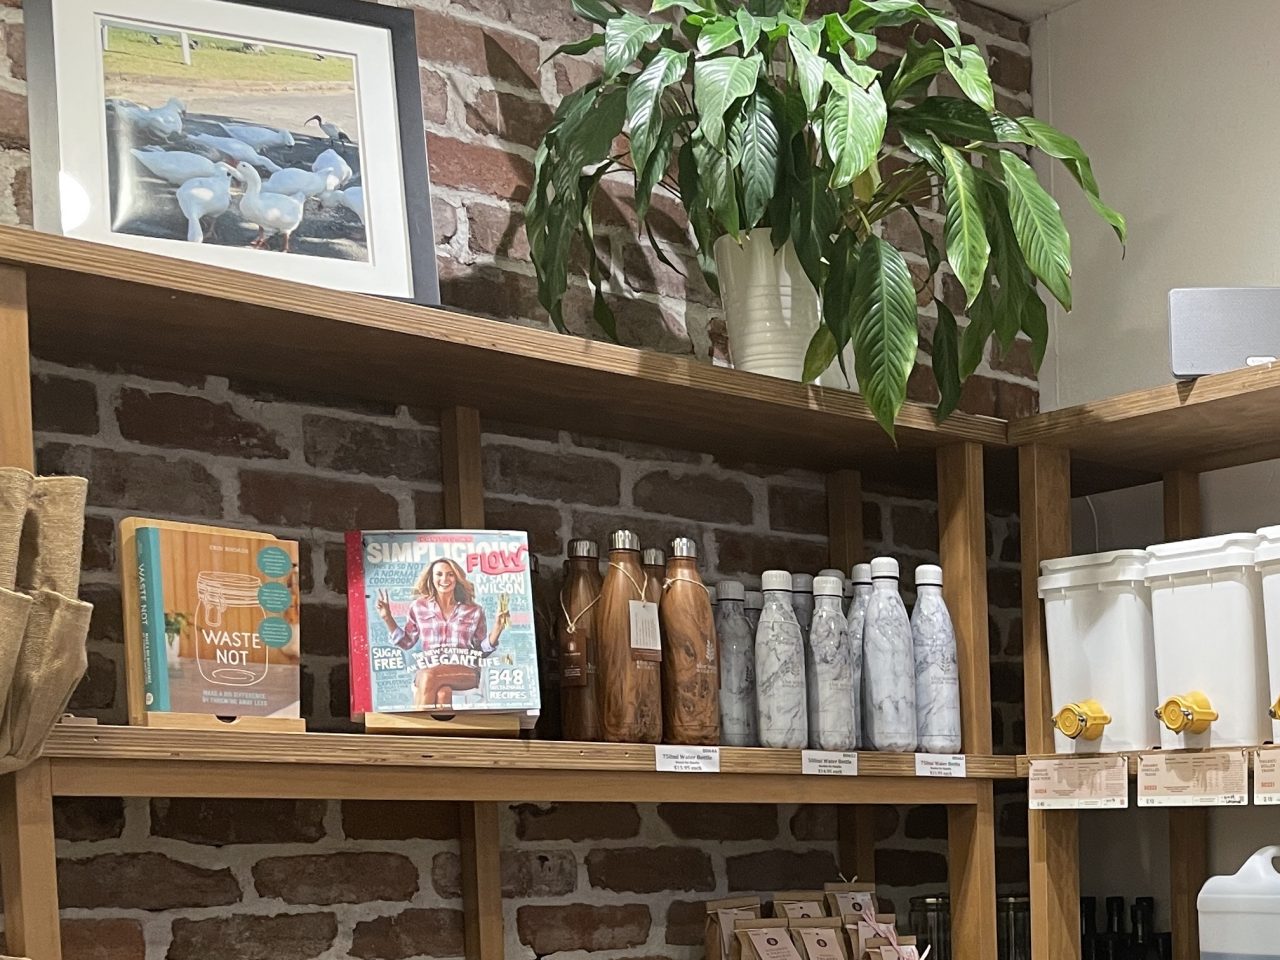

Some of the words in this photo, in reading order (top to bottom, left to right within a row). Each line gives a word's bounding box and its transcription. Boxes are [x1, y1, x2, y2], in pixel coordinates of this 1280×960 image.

[407, 562, 425, 570] NOT
[466, 544, 528, 575] FLOW
[138, 563, 148, 602] WASTE
[476, 573, 487, 583] BY
[488, 573, 524, 584] SARAH
[476, 583, 525, 595] WILSON
[140, 603, 148, 625] NOT
[202, 629, 262, 649] WASTE
[216, 649, 249, 666] NOT
[373, 647, 402, 659] SUGAR
[374, 658, 404, 670] FREE
[416, 654, 478, 669] ELEGANT
[478, 656, 501, 668] LIFE
[489, 669, 524, 685] 348
[489, 691, 527, 700] RECIPES
